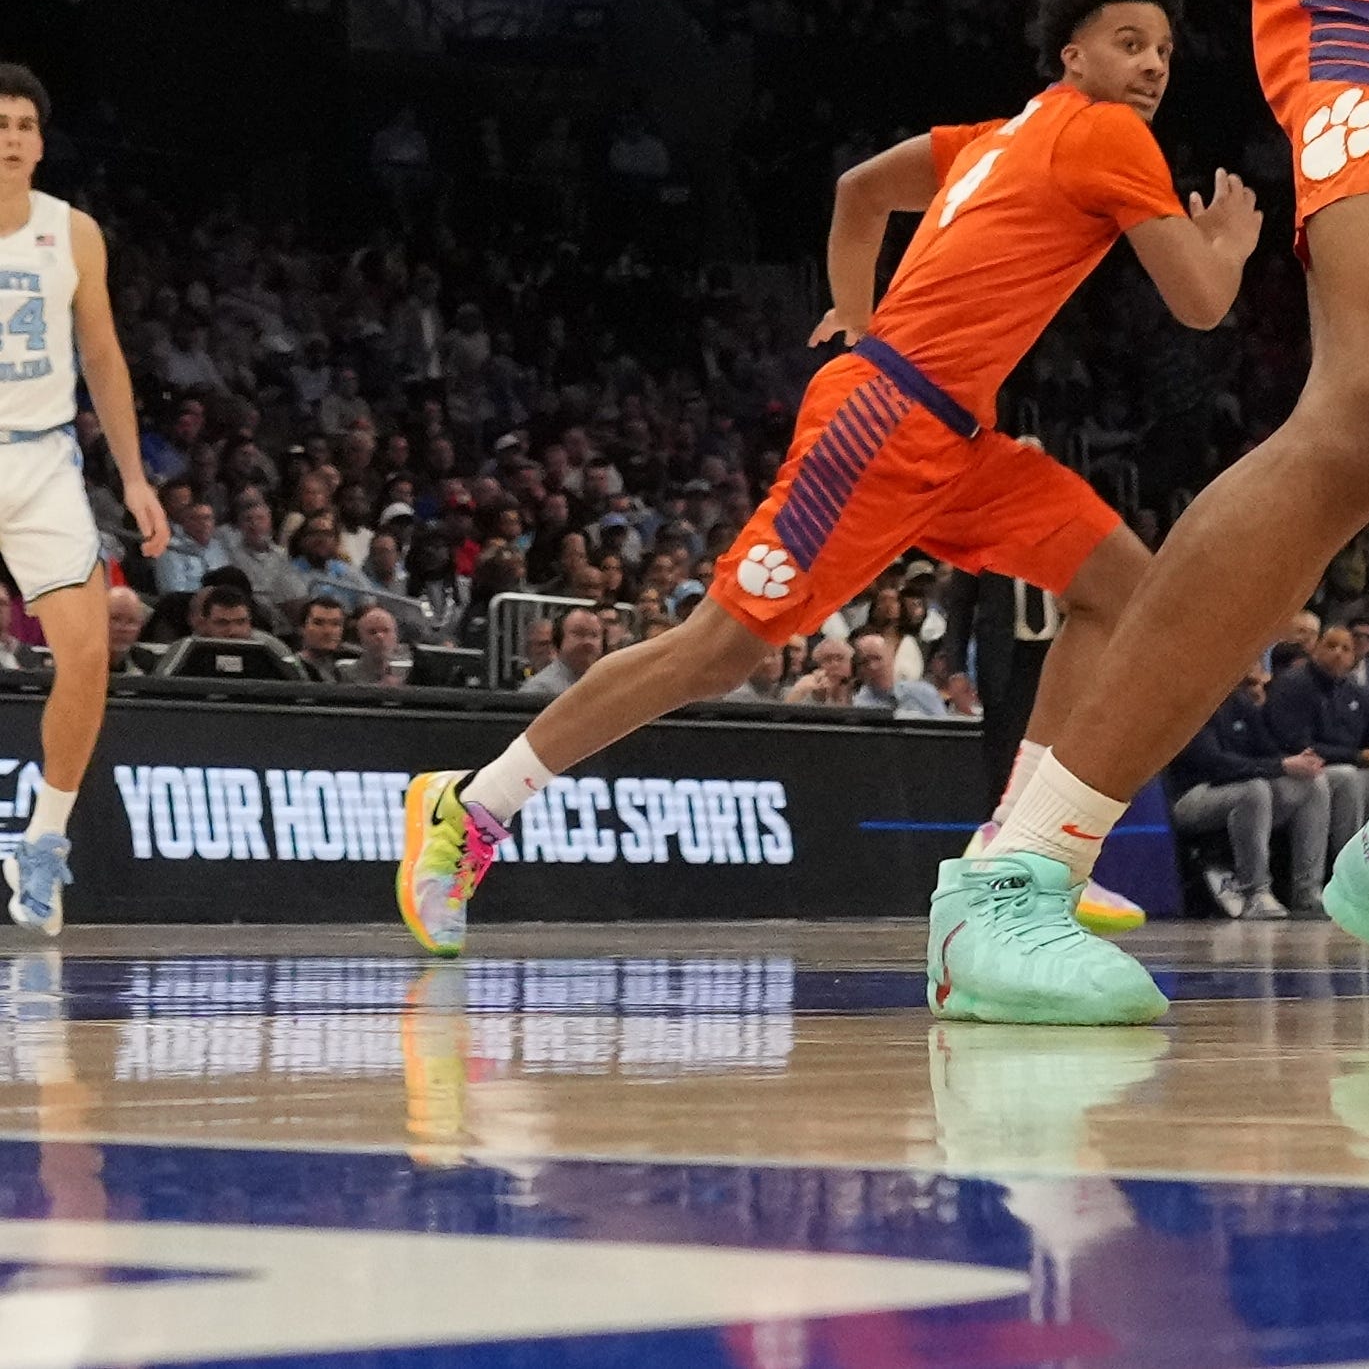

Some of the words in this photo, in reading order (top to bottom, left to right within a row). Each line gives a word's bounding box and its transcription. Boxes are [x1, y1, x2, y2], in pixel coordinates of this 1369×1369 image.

[0, 296, 47, 351] 4
[113, 764, 271, 861] YOUR
[265, 768, 411, 862] HOME
[520, 775, 617, 864] ACC
[614, 779, 795, 866] SPORTS
